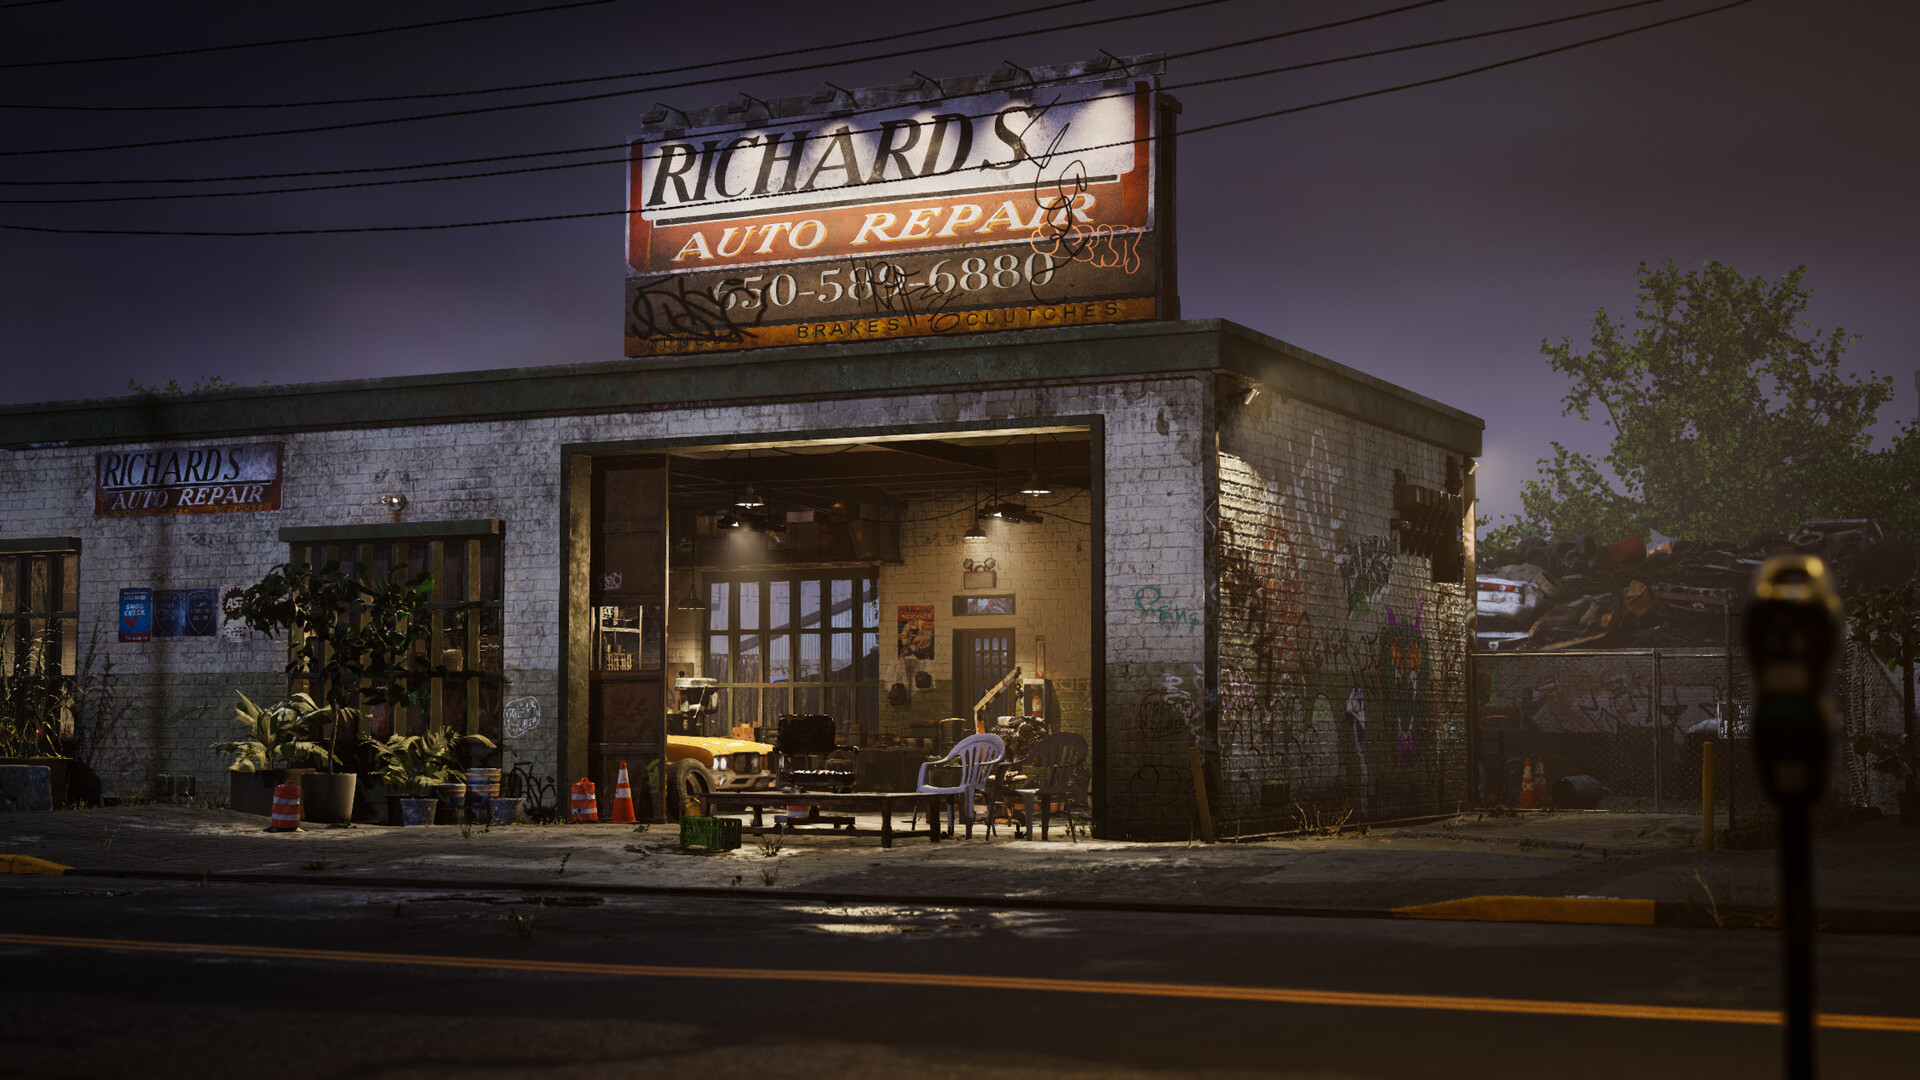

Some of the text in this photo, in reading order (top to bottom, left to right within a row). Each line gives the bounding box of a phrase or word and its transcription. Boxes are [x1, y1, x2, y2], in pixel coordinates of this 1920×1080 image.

[671, 192, 1097, 262] AUTO REPAIR
[713, 252, 1055, 311] 650-589-6880
[797, 317, 900, 339] BRAKES
[966, 302, 1118, 326] CLUTCHES
[111, 485, 264, 510] AUTO REPAIR
